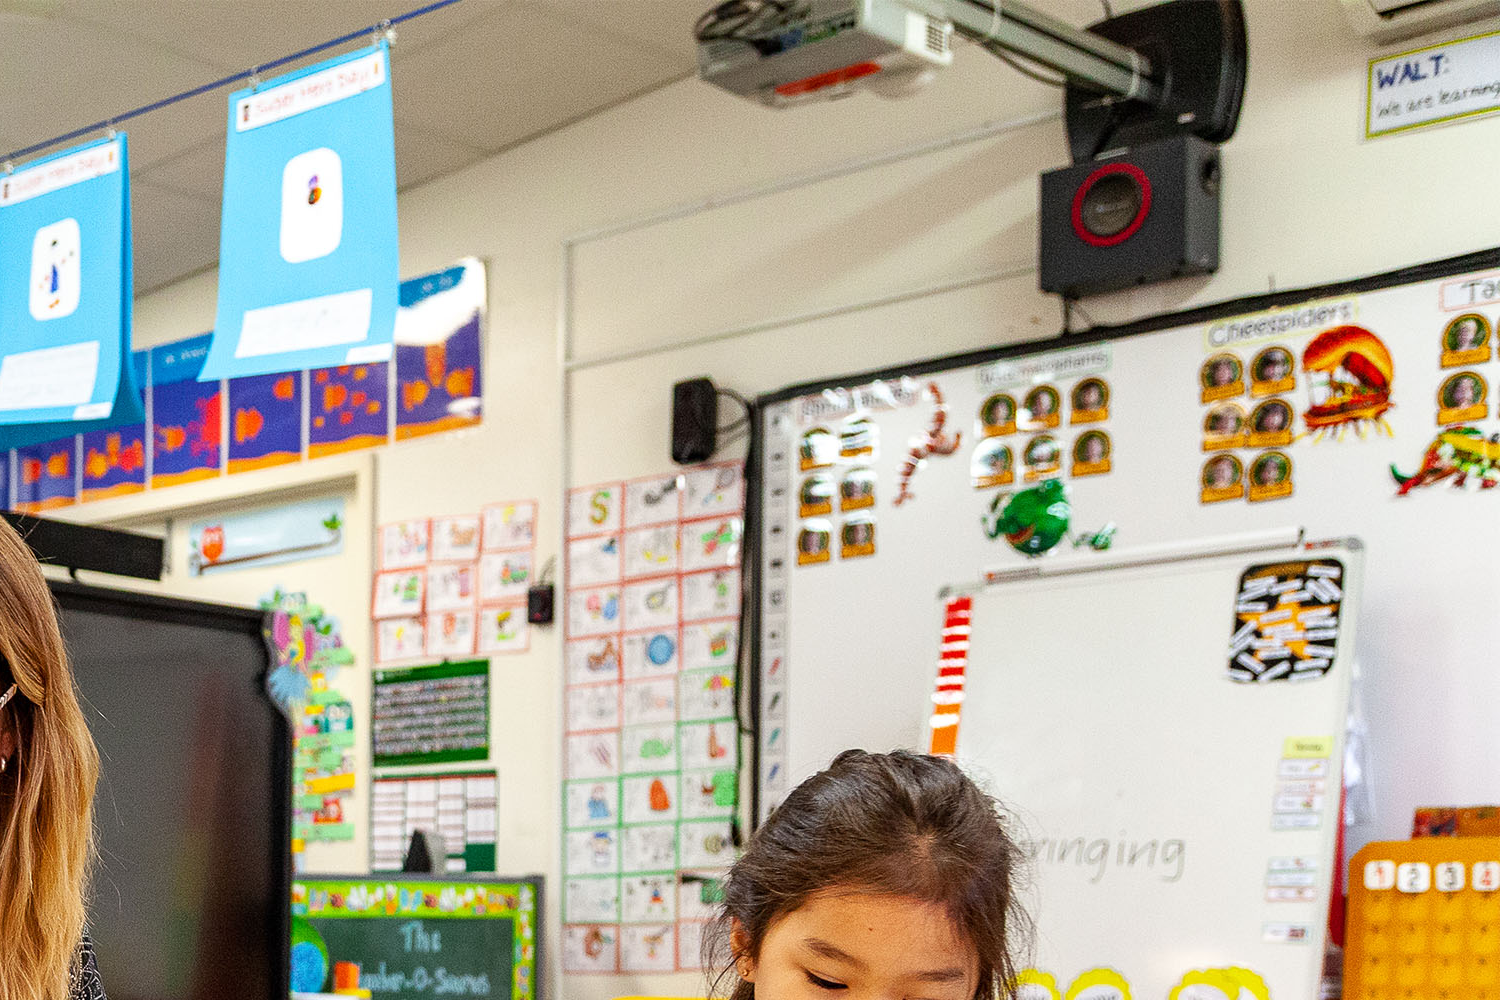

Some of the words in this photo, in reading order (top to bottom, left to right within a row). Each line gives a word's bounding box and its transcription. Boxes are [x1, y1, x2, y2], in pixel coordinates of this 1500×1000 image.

[1377, 53, 1450, 89] WALT:
[1460, 278, 1500, 306] Ta
[400, 918, 443, 954] The
